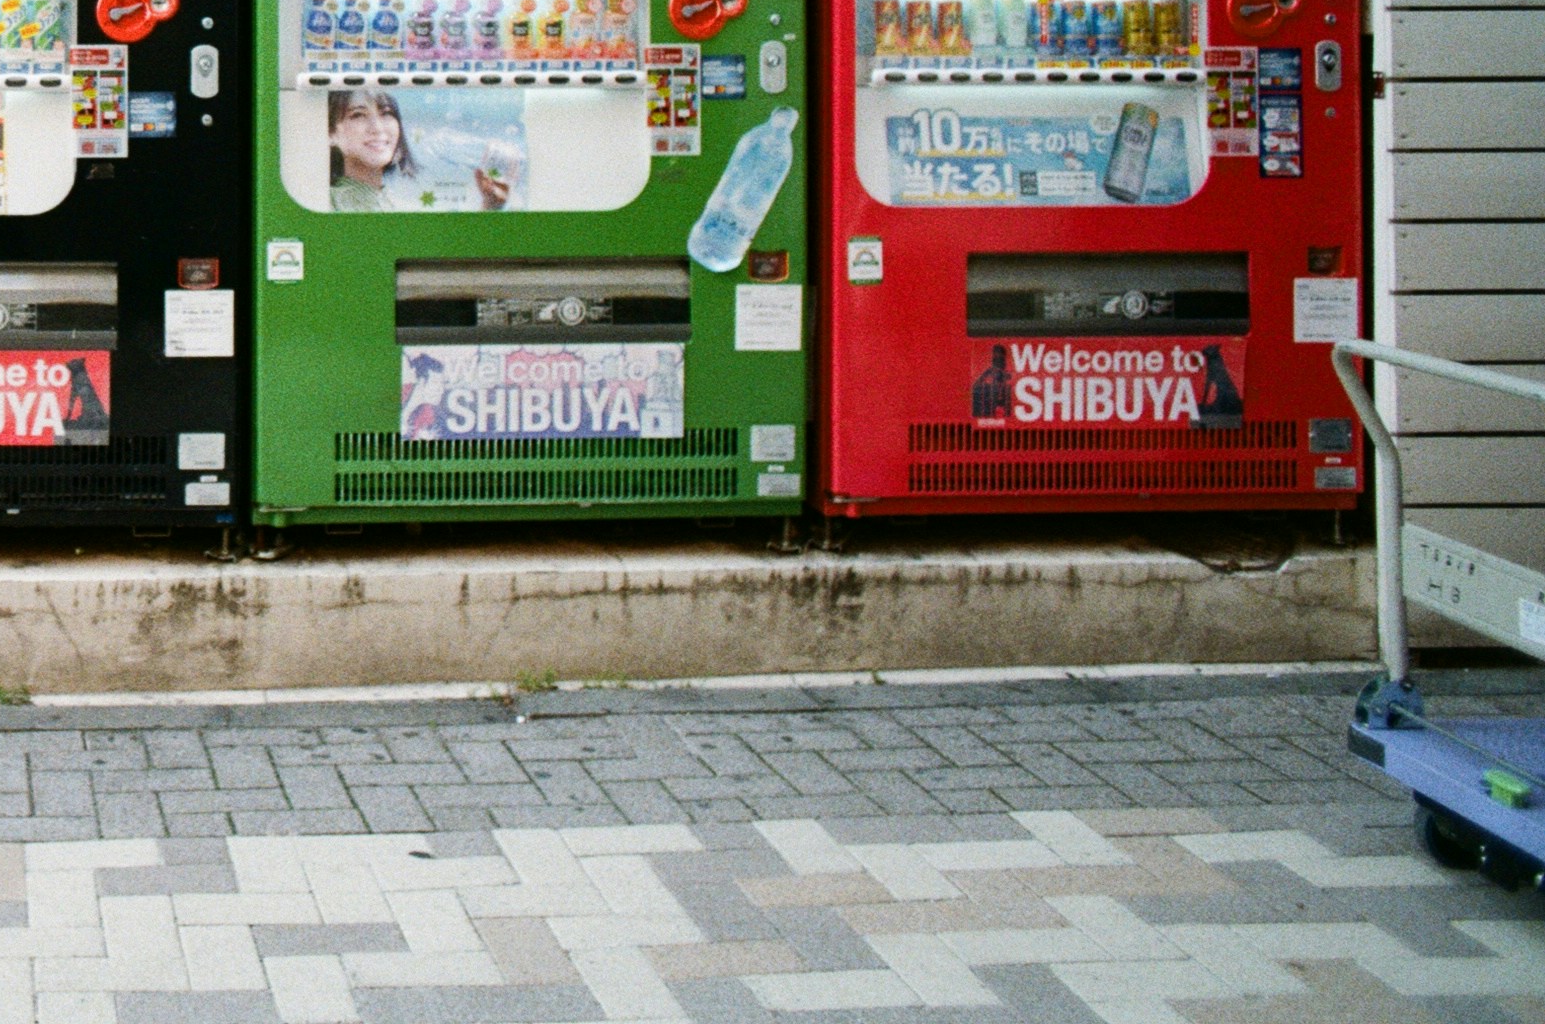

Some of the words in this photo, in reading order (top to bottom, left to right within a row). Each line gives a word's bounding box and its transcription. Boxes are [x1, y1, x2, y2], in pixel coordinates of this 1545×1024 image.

[34, 359, 71, 387] to
[447, 355, 604, 383] Welcome
[615, 355, 650, 383] to
[1011, 343, 1164, 373] Welcome
[1171, 344, 1205, 374] to
[445, 387, 641, 433] SHIBUYA
[1014, 376, 1201, 422] SHIBUYA
